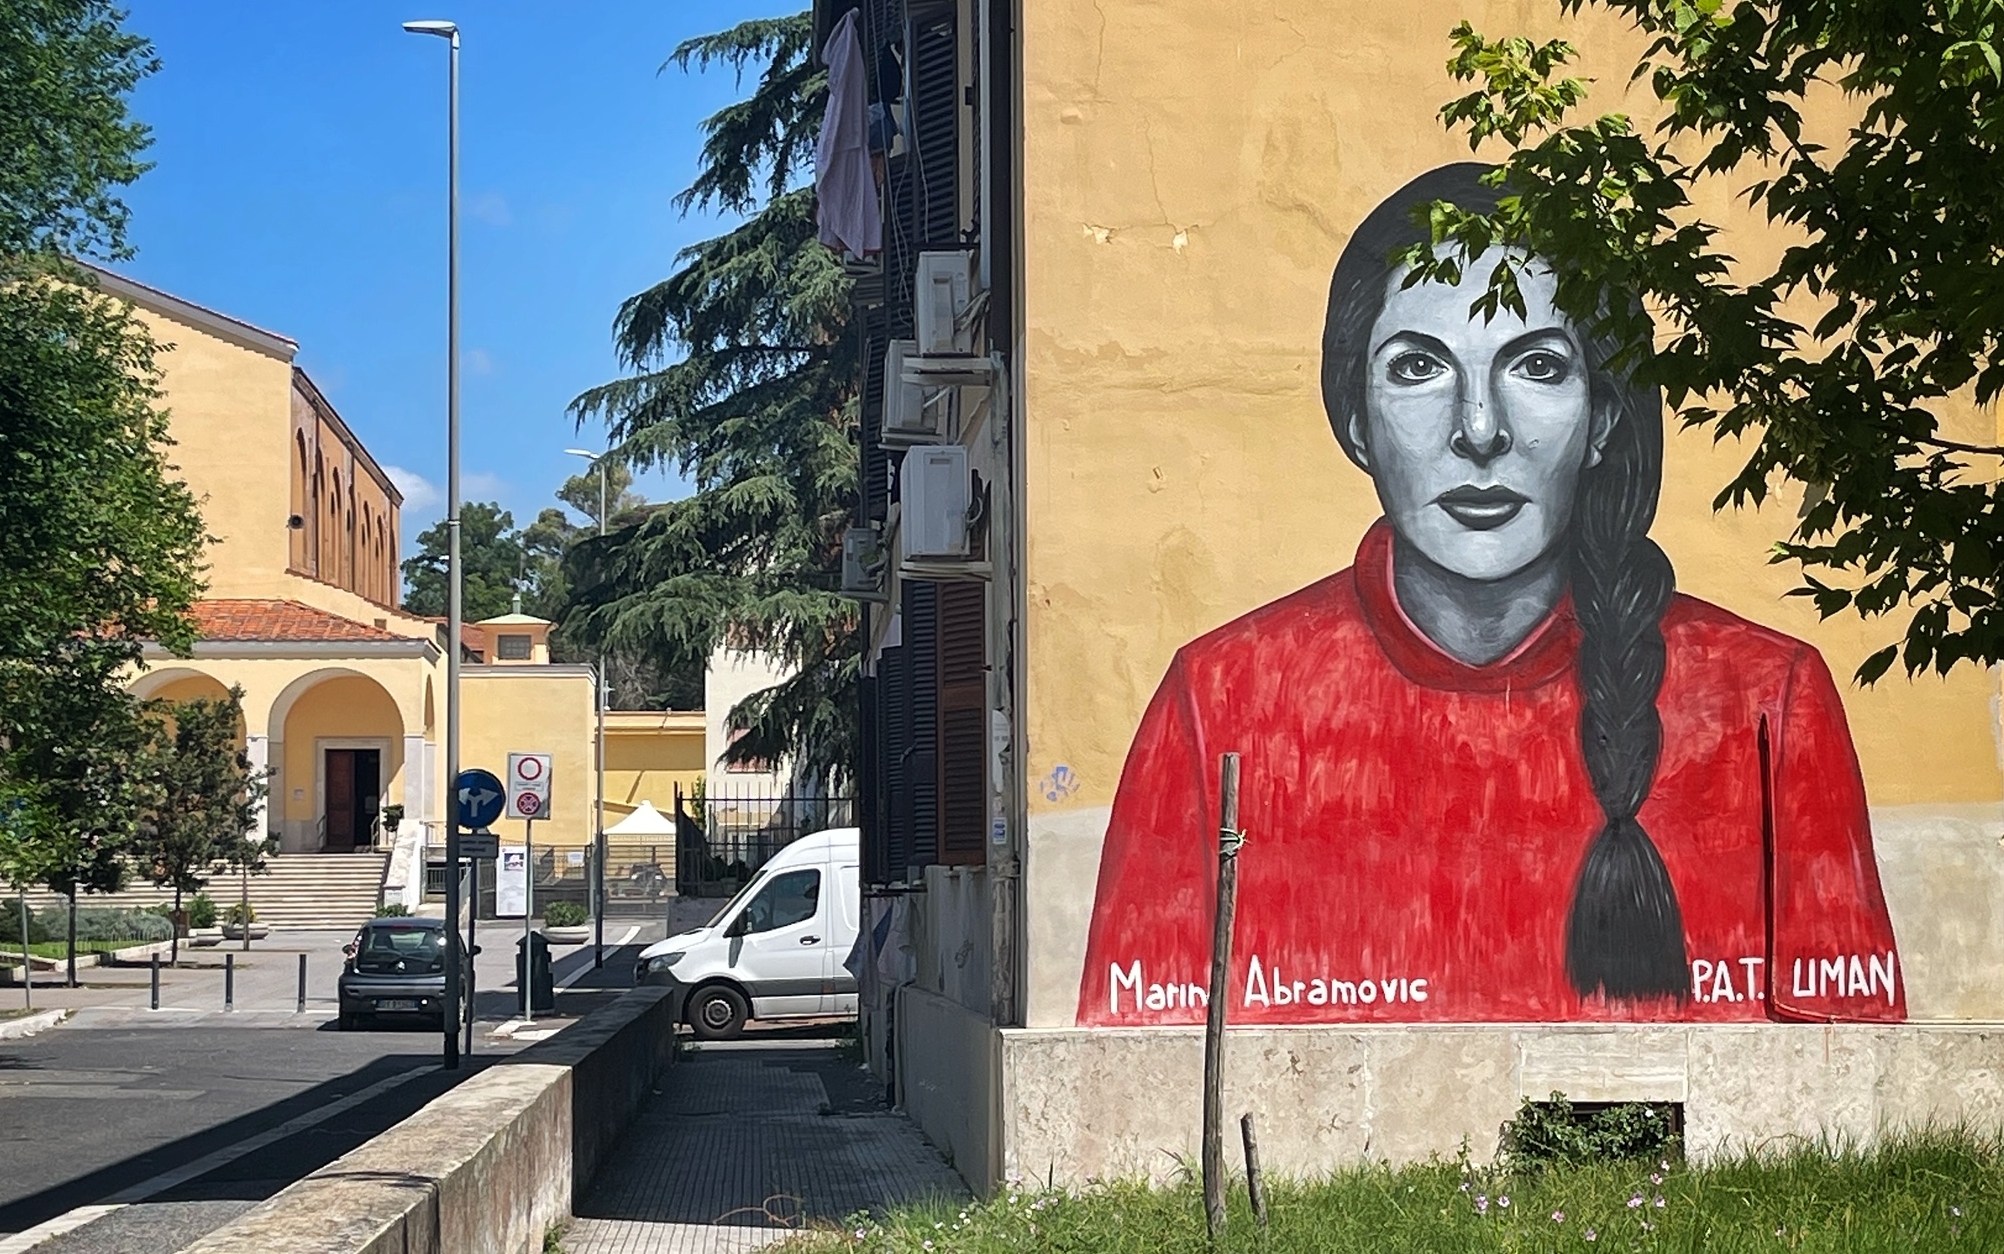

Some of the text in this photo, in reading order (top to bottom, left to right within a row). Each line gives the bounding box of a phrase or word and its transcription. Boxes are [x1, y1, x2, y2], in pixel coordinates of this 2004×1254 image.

[1109, 954, 1428, 1015] Marin Abramovic
[1691, 950, 1895, 1007] P.A.T. UMAN
